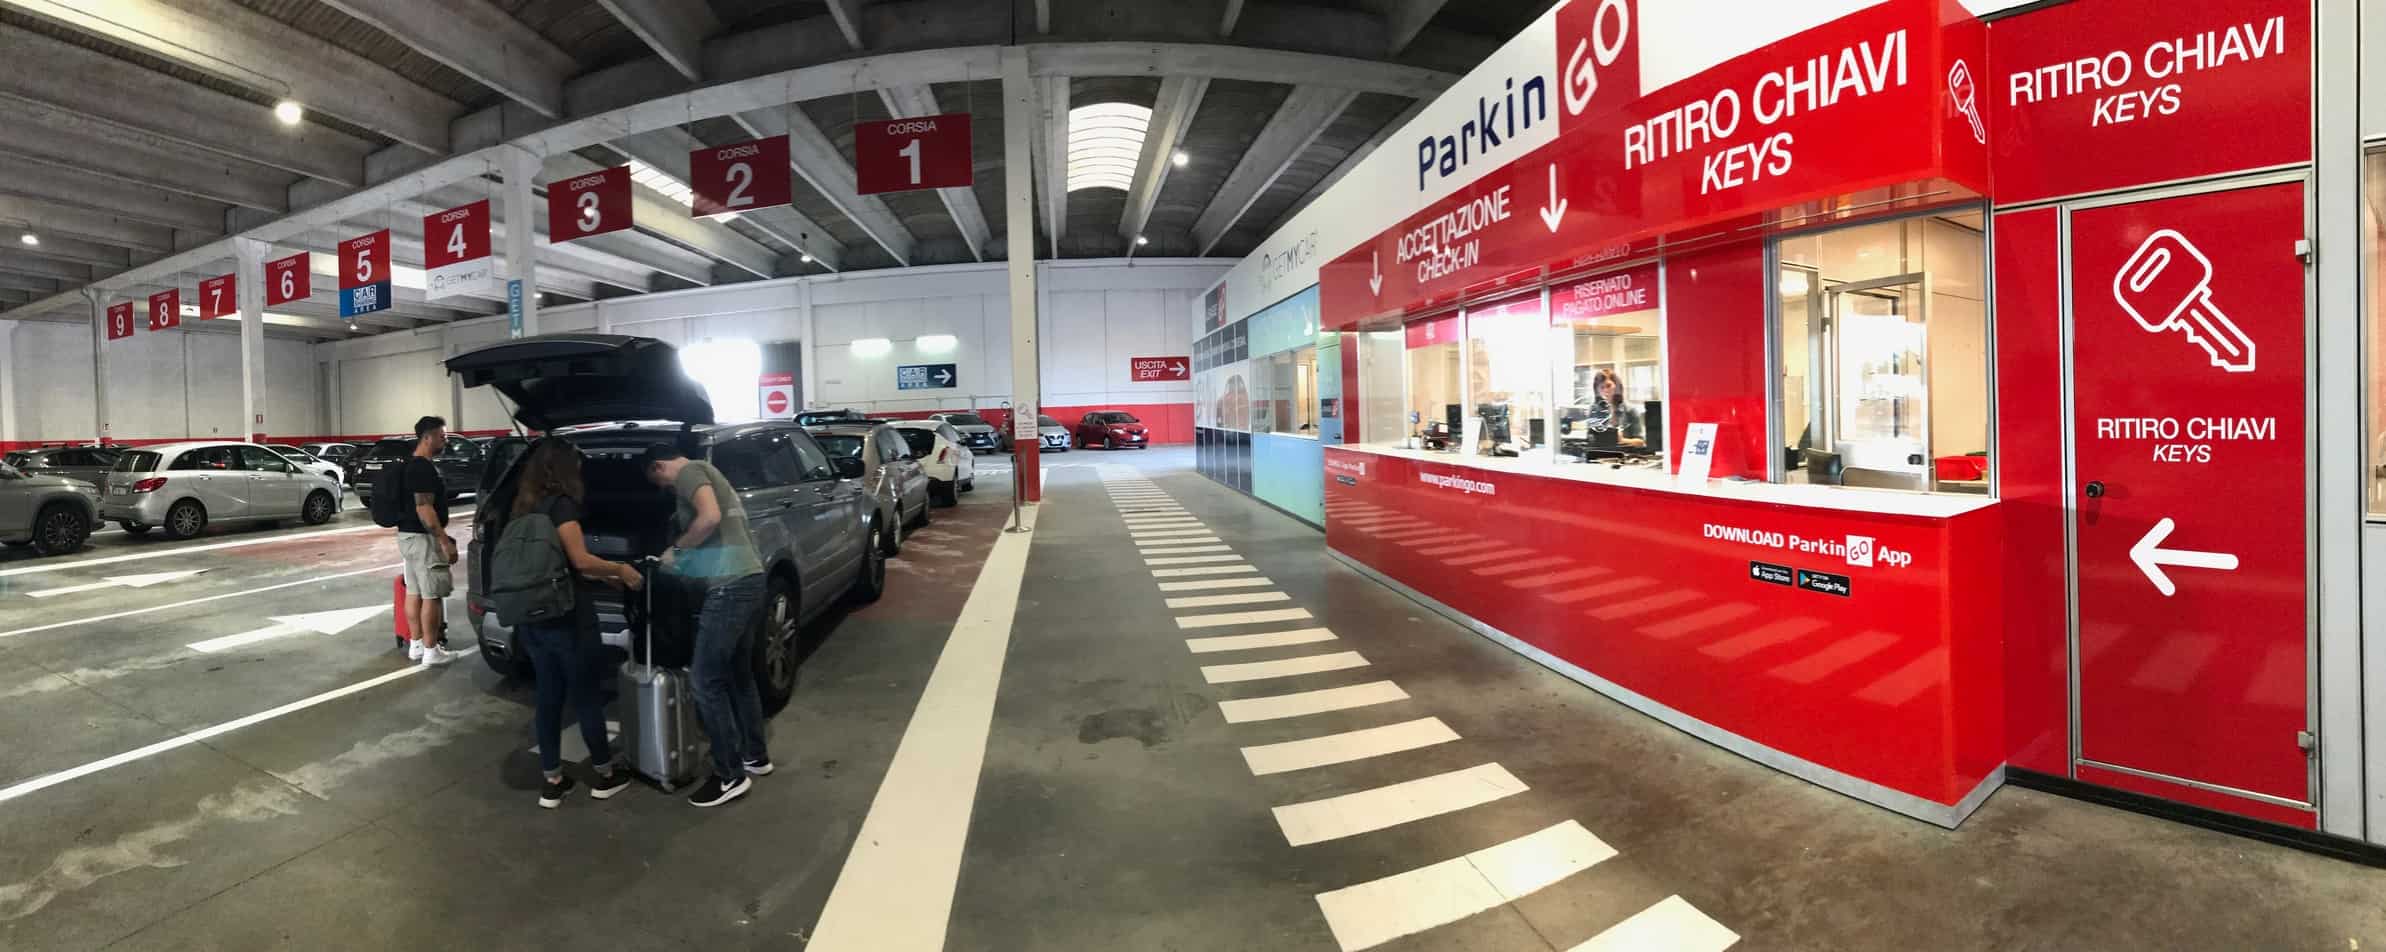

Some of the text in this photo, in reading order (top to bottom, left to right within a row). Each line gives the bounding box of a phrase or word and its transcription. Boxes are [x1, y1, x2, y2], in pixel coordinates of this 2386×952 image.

[2009, 16, 2285, 107] RITIRO CHIAVI
[1624, 28, 1908, 171] RITIRO CHIAVI
[2091, 83, 2182, 127] KEYS
[887, 120, 937, 136] CORSIA
[717, 144, 760, 161] CORSIA
[899, 138, 922, 185] 1
[1700, 132, 1794, 195] KEYS
[569, 174, 607, 191] CORSIA
[725, 162, 755, 208] 2
[576, 191, 602, 232] 3
[1396, 184, 1511, 265] ACCETTAZIONE
[351, 236, 376, 250] CORSIA
[447, 223, 468, 258] 4
[356, 249, 373, 282] 5
[1417, 238, 1480, 283] CHECK-IN
[281, 270, 294, 300] 6
[1574, 274, 1632, 298] RISERVATO
[159, 302, 169, 326] 8
[211, 288, 223, 315] 7
[1562, 288, 1646, 315] PAGATO ONLINE
[115, 314, 125, 337] 9
[1134, 360, 1168, 370] USCITA
[1140, 369, 1161, 378] EXIT
[2097, 416, 2276, 440] RITIRO CHIAVI
[2152, 443, 2212, 463] KEYS
[1419, 471, 1496, 496] www.parkingo.com
[1703, 523, 1785, 548] DOWNLOAD
[1877, 545, 1912, 567] App
[1811, 579, 1834, 591] Google
